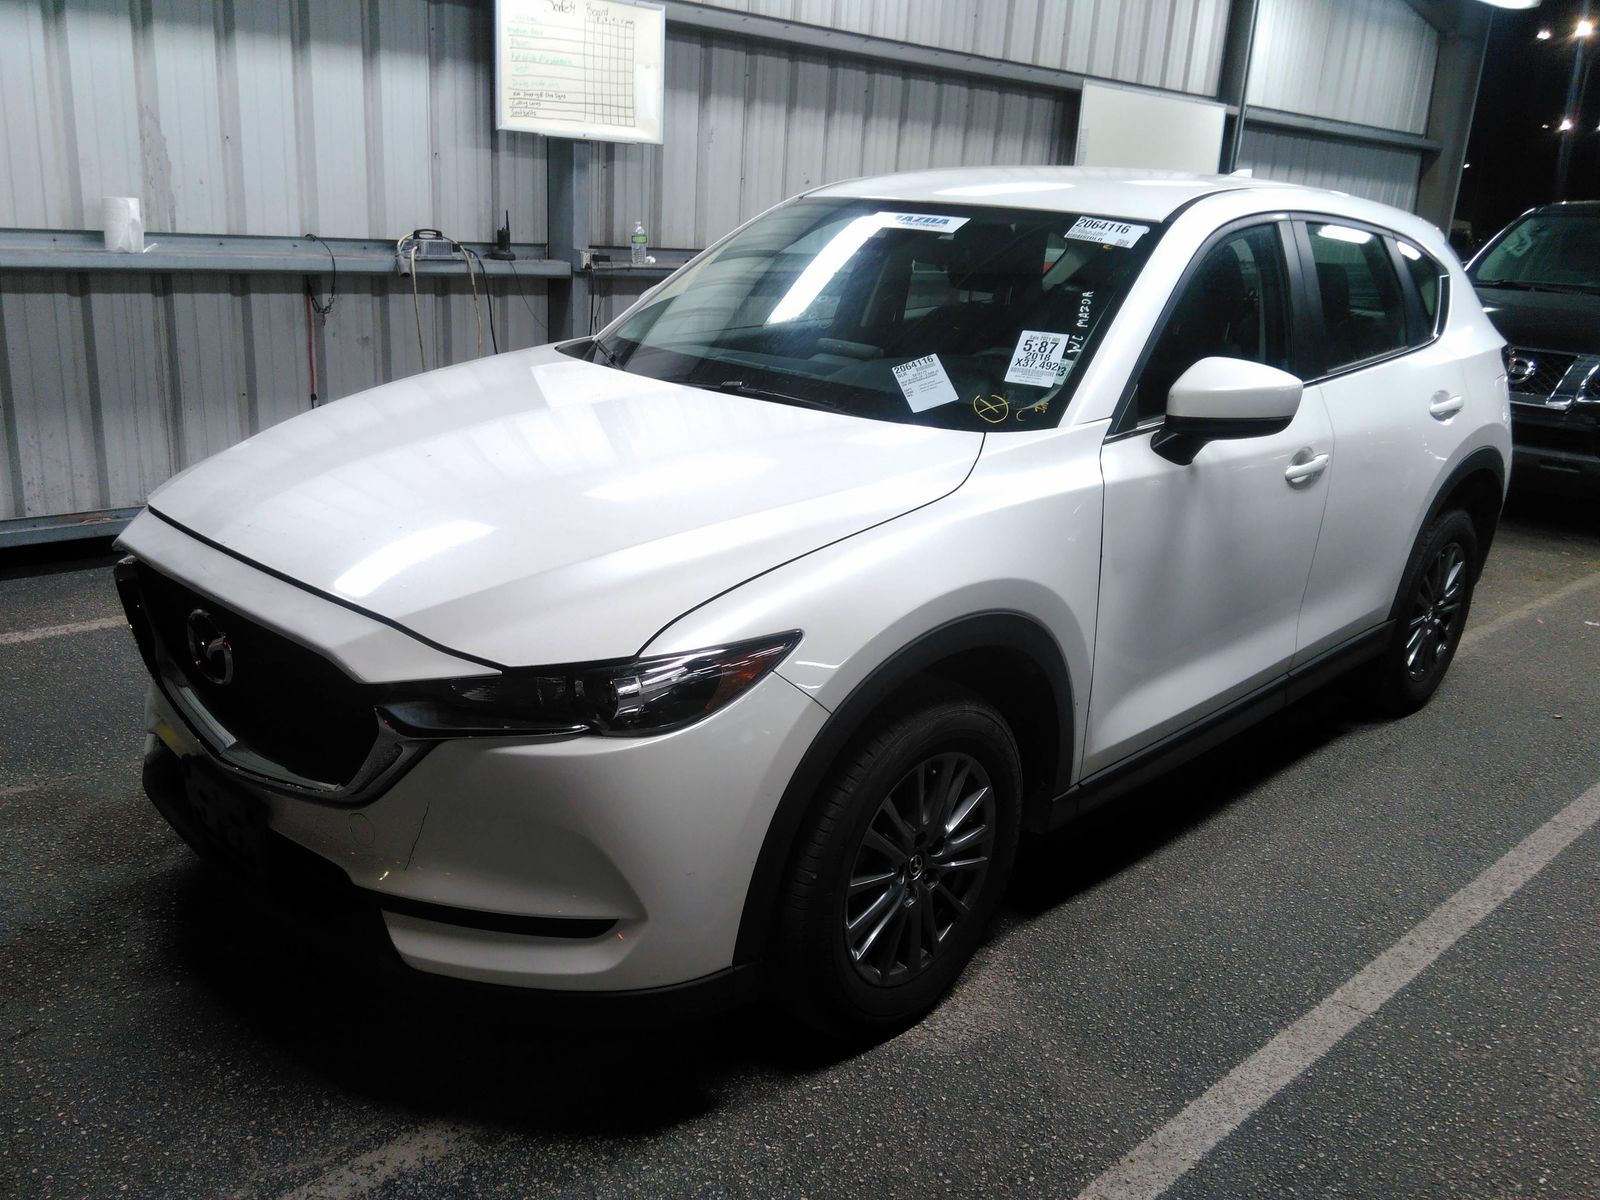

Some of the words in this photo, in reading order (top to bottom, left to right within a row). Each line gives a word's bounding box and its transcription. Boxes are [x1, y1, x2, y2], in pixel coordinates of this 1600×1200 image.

[586, 2, 609, 16] Board
[1076, 218, 1132, 234] 2064116
[1023, 339, 1059, 354] 5:87
[1025, 352, 1051, 361] 2018
[894, 355, 934, 375] 2064116
